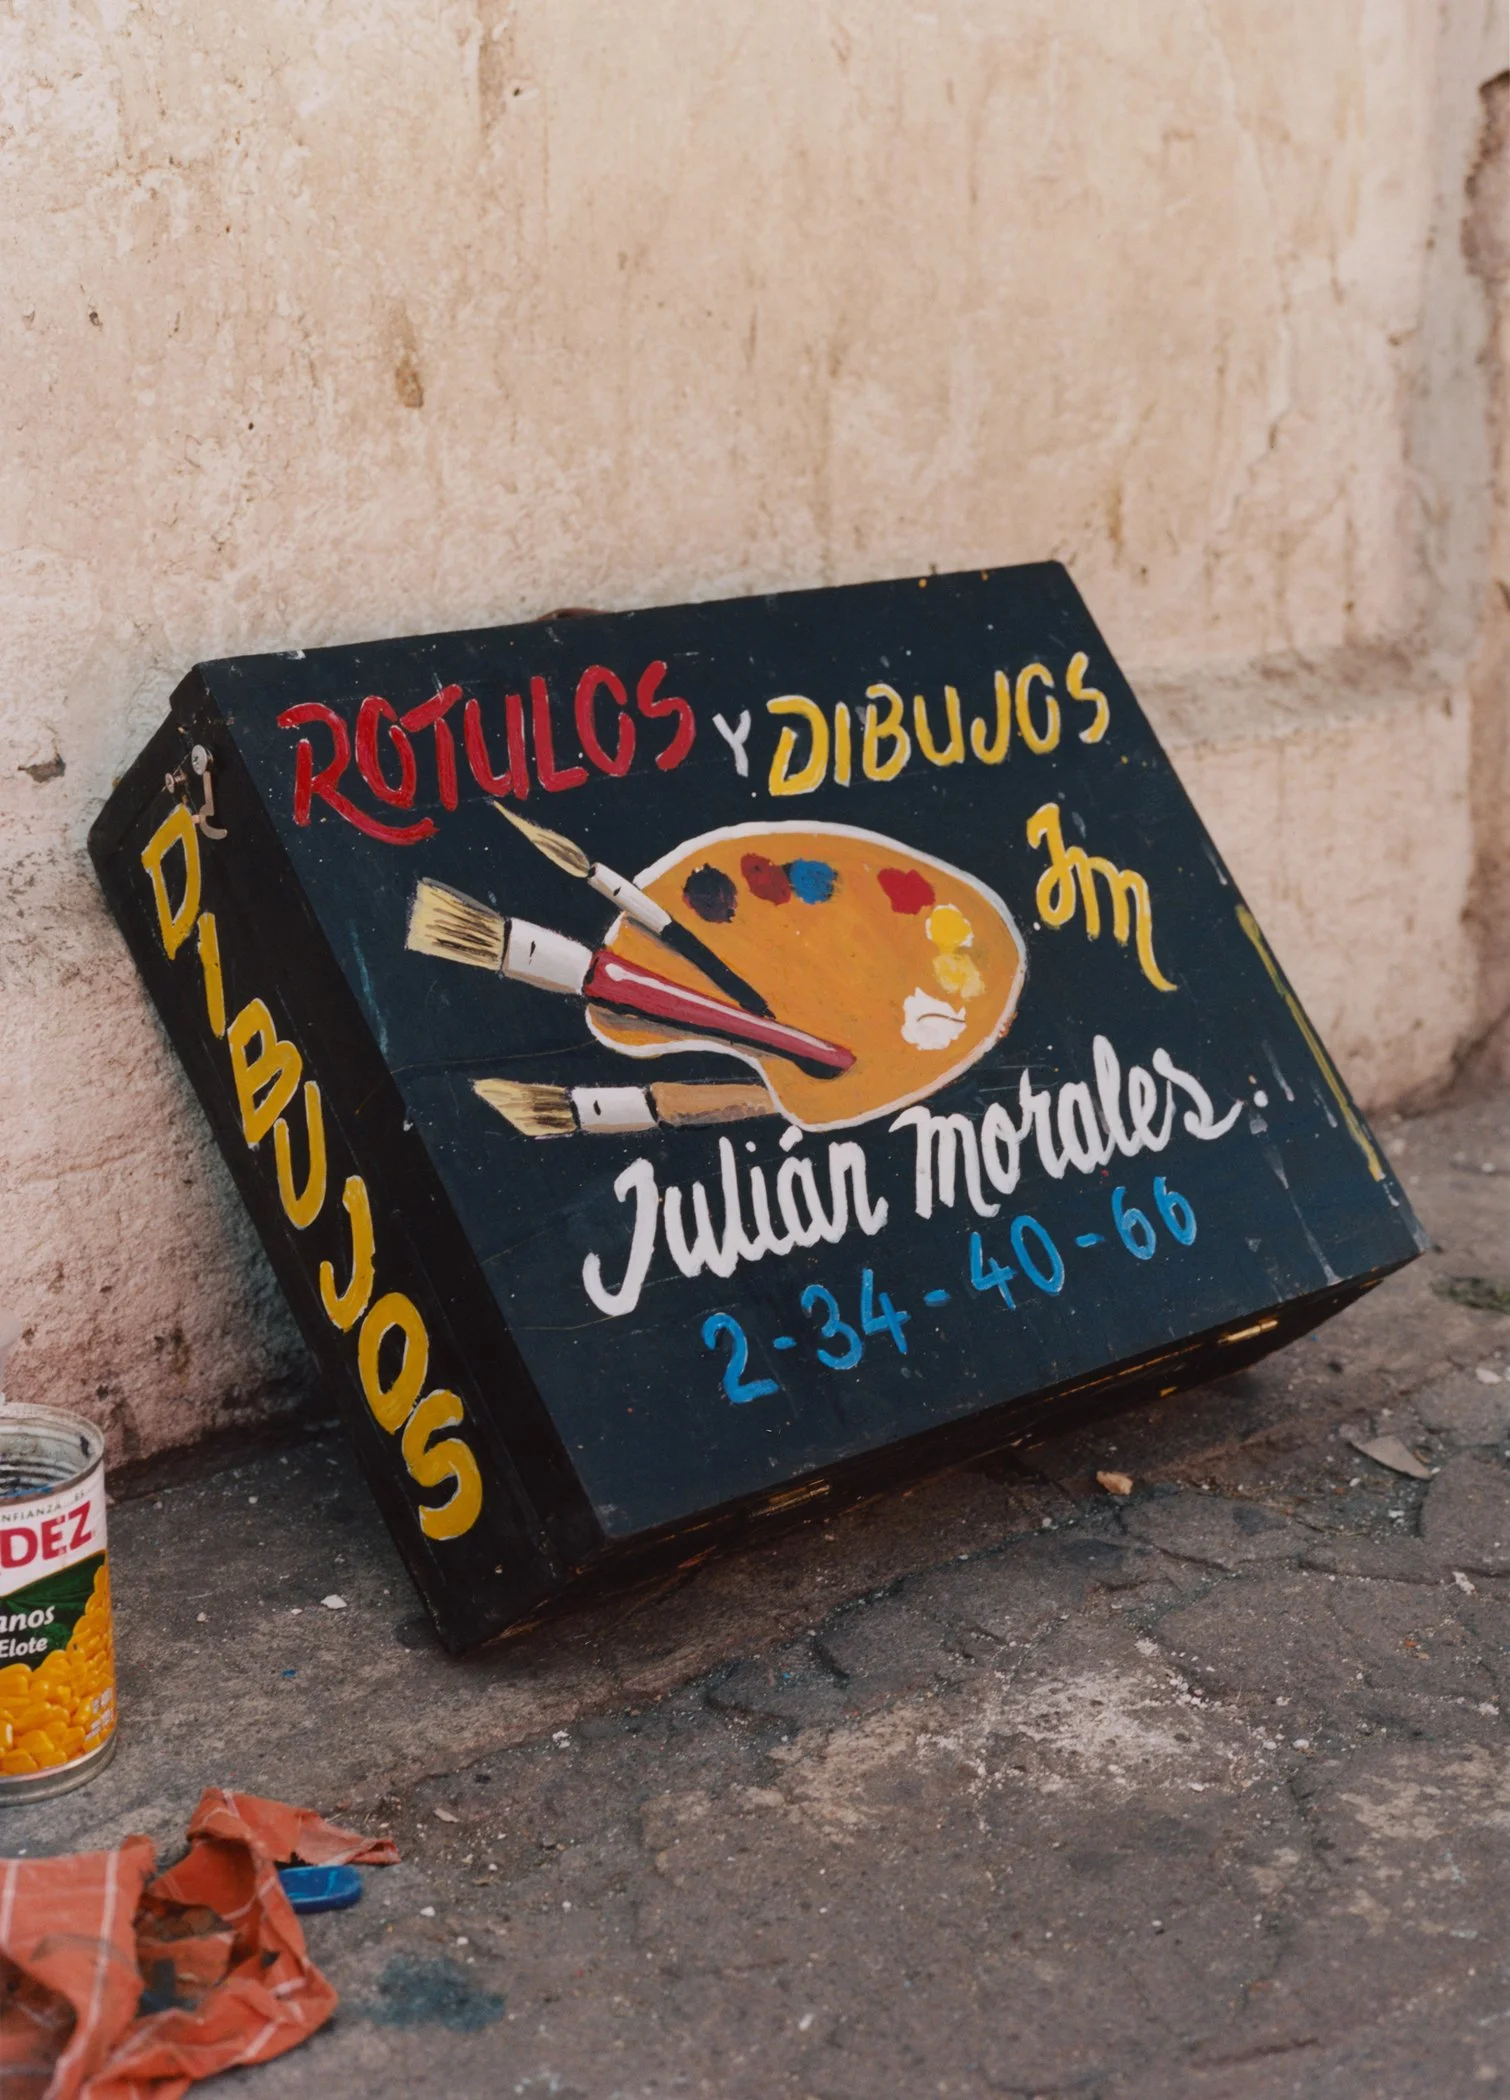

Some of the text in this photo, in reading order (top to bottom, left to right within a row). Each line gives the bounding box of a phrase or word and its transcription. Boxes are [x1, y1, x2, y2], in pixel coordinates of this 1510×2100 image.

[277, 660, 696, 845] ROTULOS
[767, 652, 1109, 796] DIBUJOS
[141, 803, 483, 1541] DIBUJOS
[582, 1127, 888, 1316] Julián
[0, 1500, 92, 1569] DEZ
[0, 1637, 48, 1658] Elote
